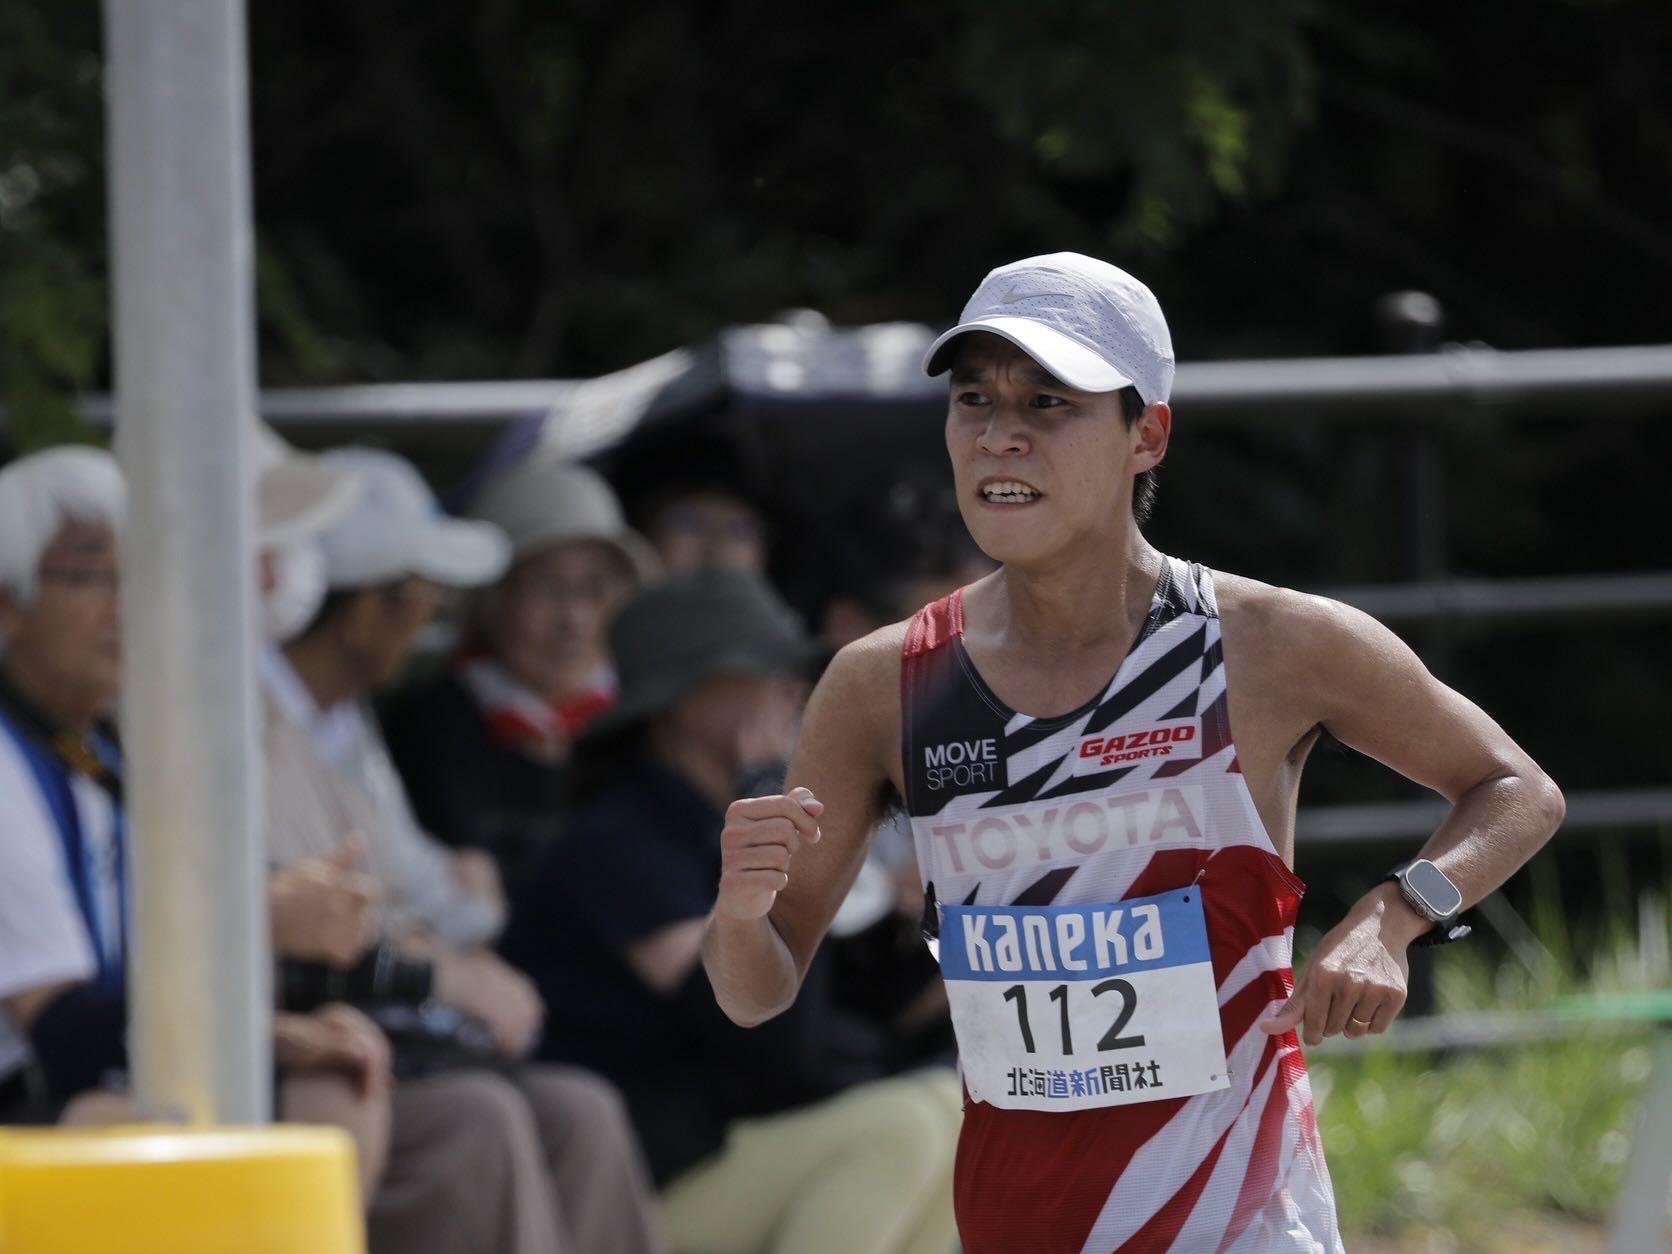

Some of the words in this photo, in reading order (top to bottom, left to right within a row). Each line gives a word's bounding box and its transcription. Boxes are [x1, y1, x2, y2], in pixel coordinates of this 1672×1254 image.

[925, 739, 997, 768] MOVE
[1080, 726, 1195, 758] GAZOO
[1100, 745, 1173, 766] SPORTS
[927, 763, 998, 790] SPORT
[931, 788, 1202, 873] TOYOTA
[1002, 978, 1146, 1055] 112
[1007, 1060, 1163, 1098] 北海道新聞社
